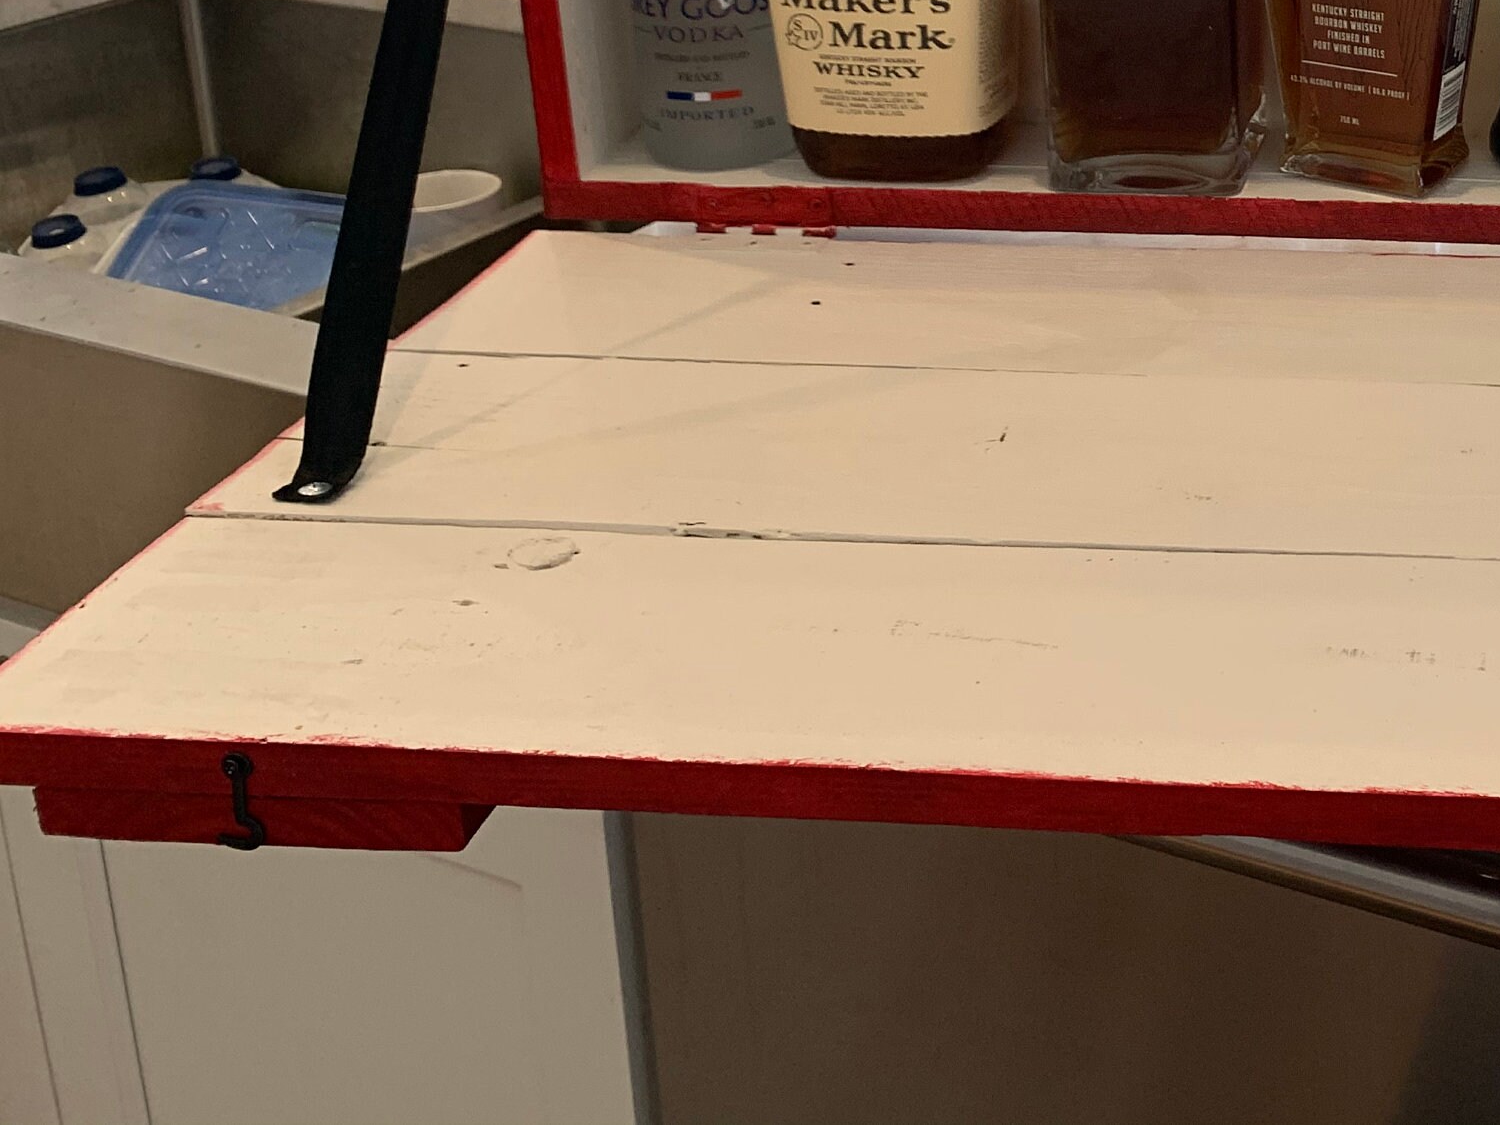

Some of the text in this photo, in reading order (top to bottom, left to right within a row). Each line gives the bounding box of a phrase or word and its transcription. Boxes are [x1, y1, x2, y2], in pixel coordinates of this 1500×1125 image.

[1311, 3, 1385, 22] KENTUCKY STRAIGHT
[653, 25, 744, 43] VODKA
[1314, 15, 1382, 34] BOURBON WHISKEY
[828, 20, 953, 51] Mark
[1327, 29, 1370, 45] FINISHED IN
[1312, 39, 1331, 51] PORT
[1353, 45, 1385, 60] BARRELS
[812, 61, 925, 79] WHISKY
